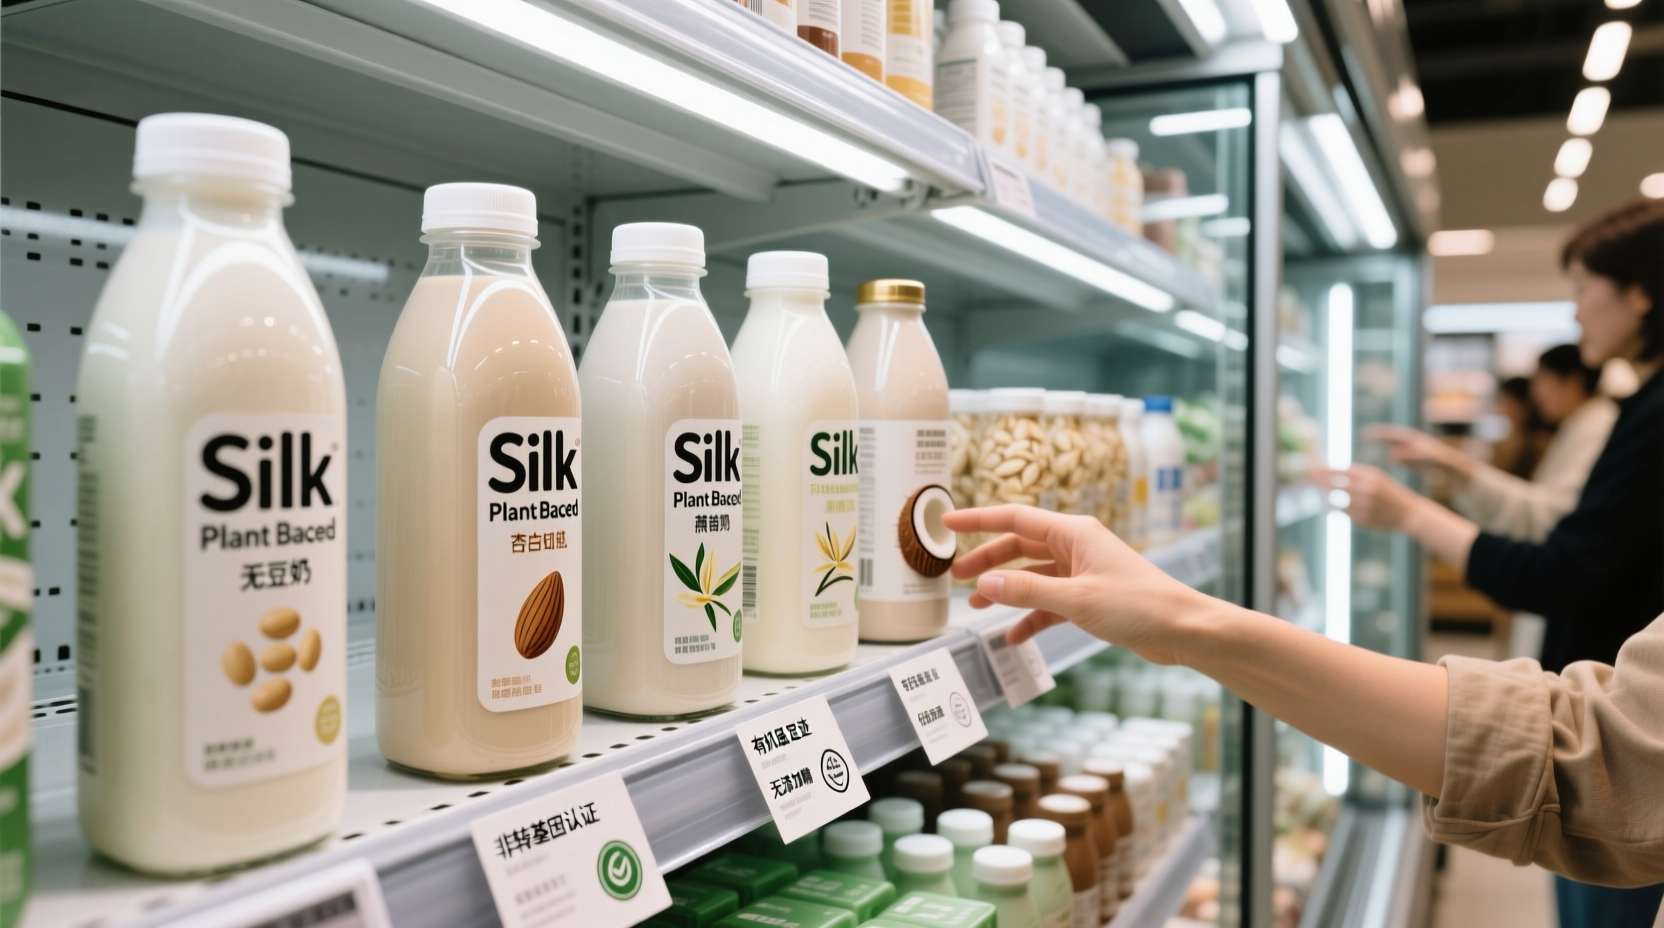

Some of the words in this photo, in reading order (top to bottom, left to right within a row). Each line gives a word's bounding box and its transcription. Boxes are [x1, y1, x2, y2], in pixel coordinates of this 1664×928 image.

[199, 432, 333, 513] Silk
[488, 430, 578, 493] Silk
[673, 430, 740, 483] Silk
[810, 430, 858, 476] Silk
[489, 502, 537, 522] Plant
[540, 498, 578, 519] Baced
[674, 491, 709, 508] Plant
[201, 524, 270, 550] Plant
[277, 517, 335, 546] Baced
